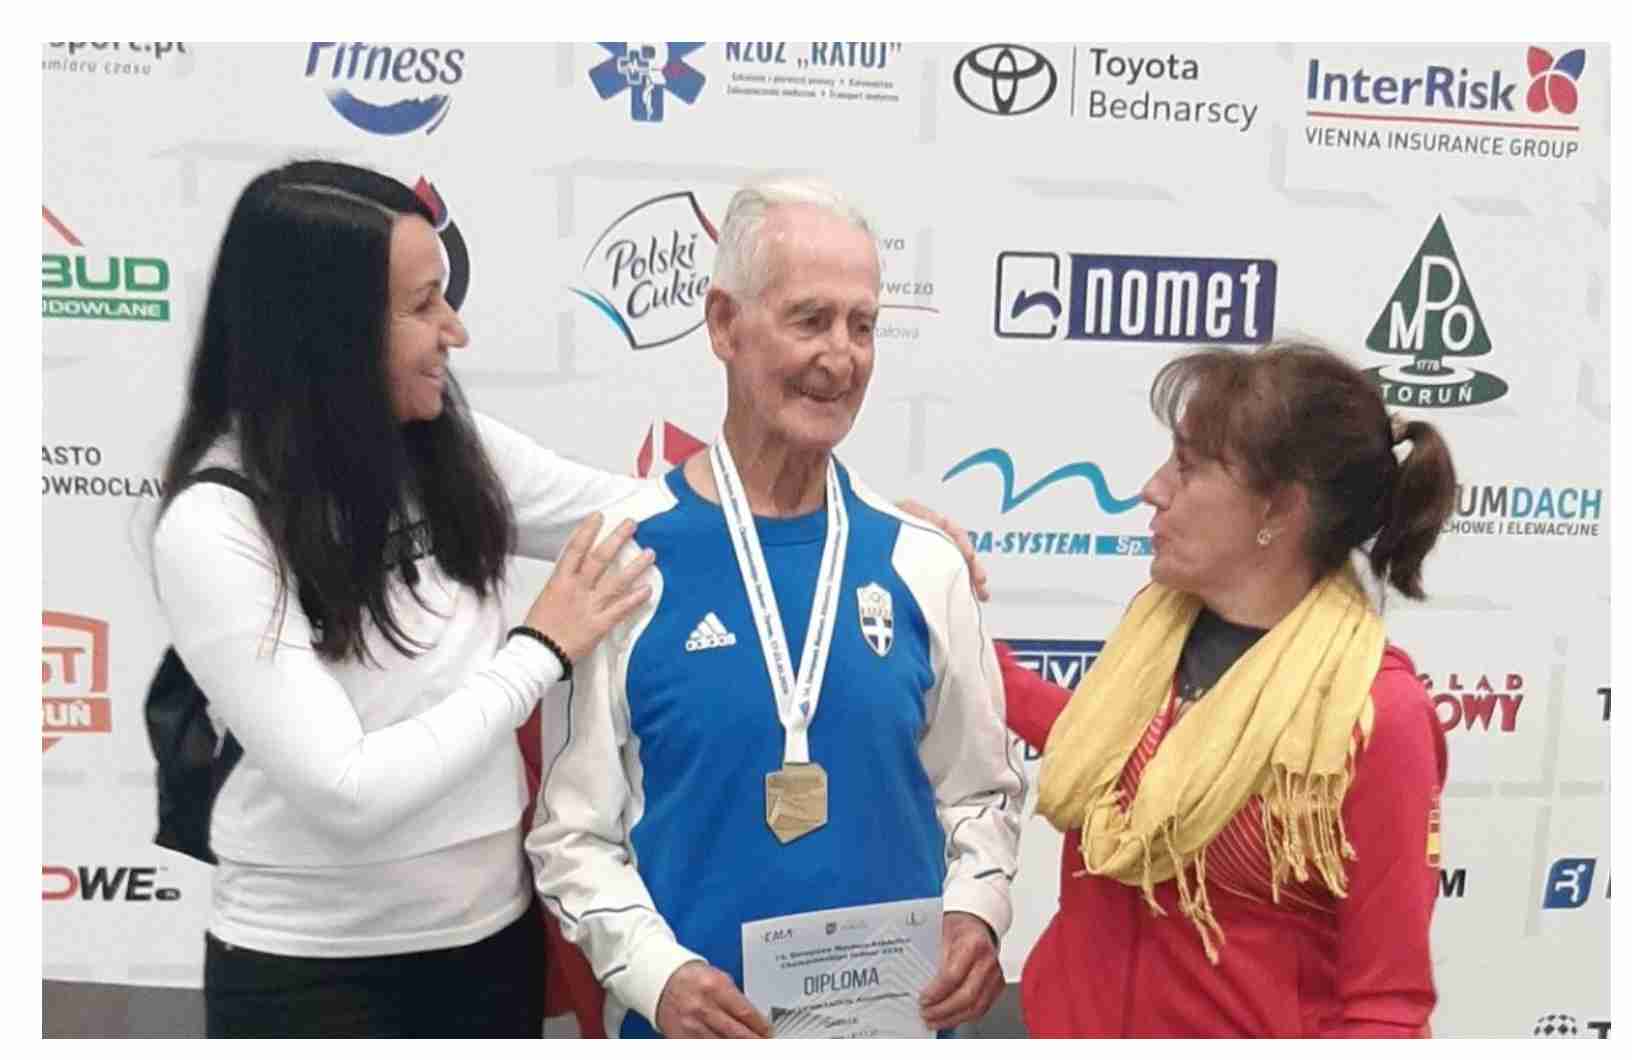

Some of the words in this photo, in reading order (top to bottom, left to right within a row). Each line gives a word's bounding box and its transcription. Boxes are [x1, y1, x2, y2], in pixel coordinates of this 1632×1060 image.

[1090, 48, 1199, 85] Toyota
[1306, 58, 1517, 111] InterRisk
[1089, 90, 1258, 132] Bednarscy
[1306, 127, 1381, 150] VIENNA
[1387, 132, 1504, 156] INSURANCE
[1509, 139, 1579, 159] GROUP
[606, 230, 698, 290] Polski
[1084, 263, 1261, 338] nomet
[803, 967, 880, 997] DIPLOMA
